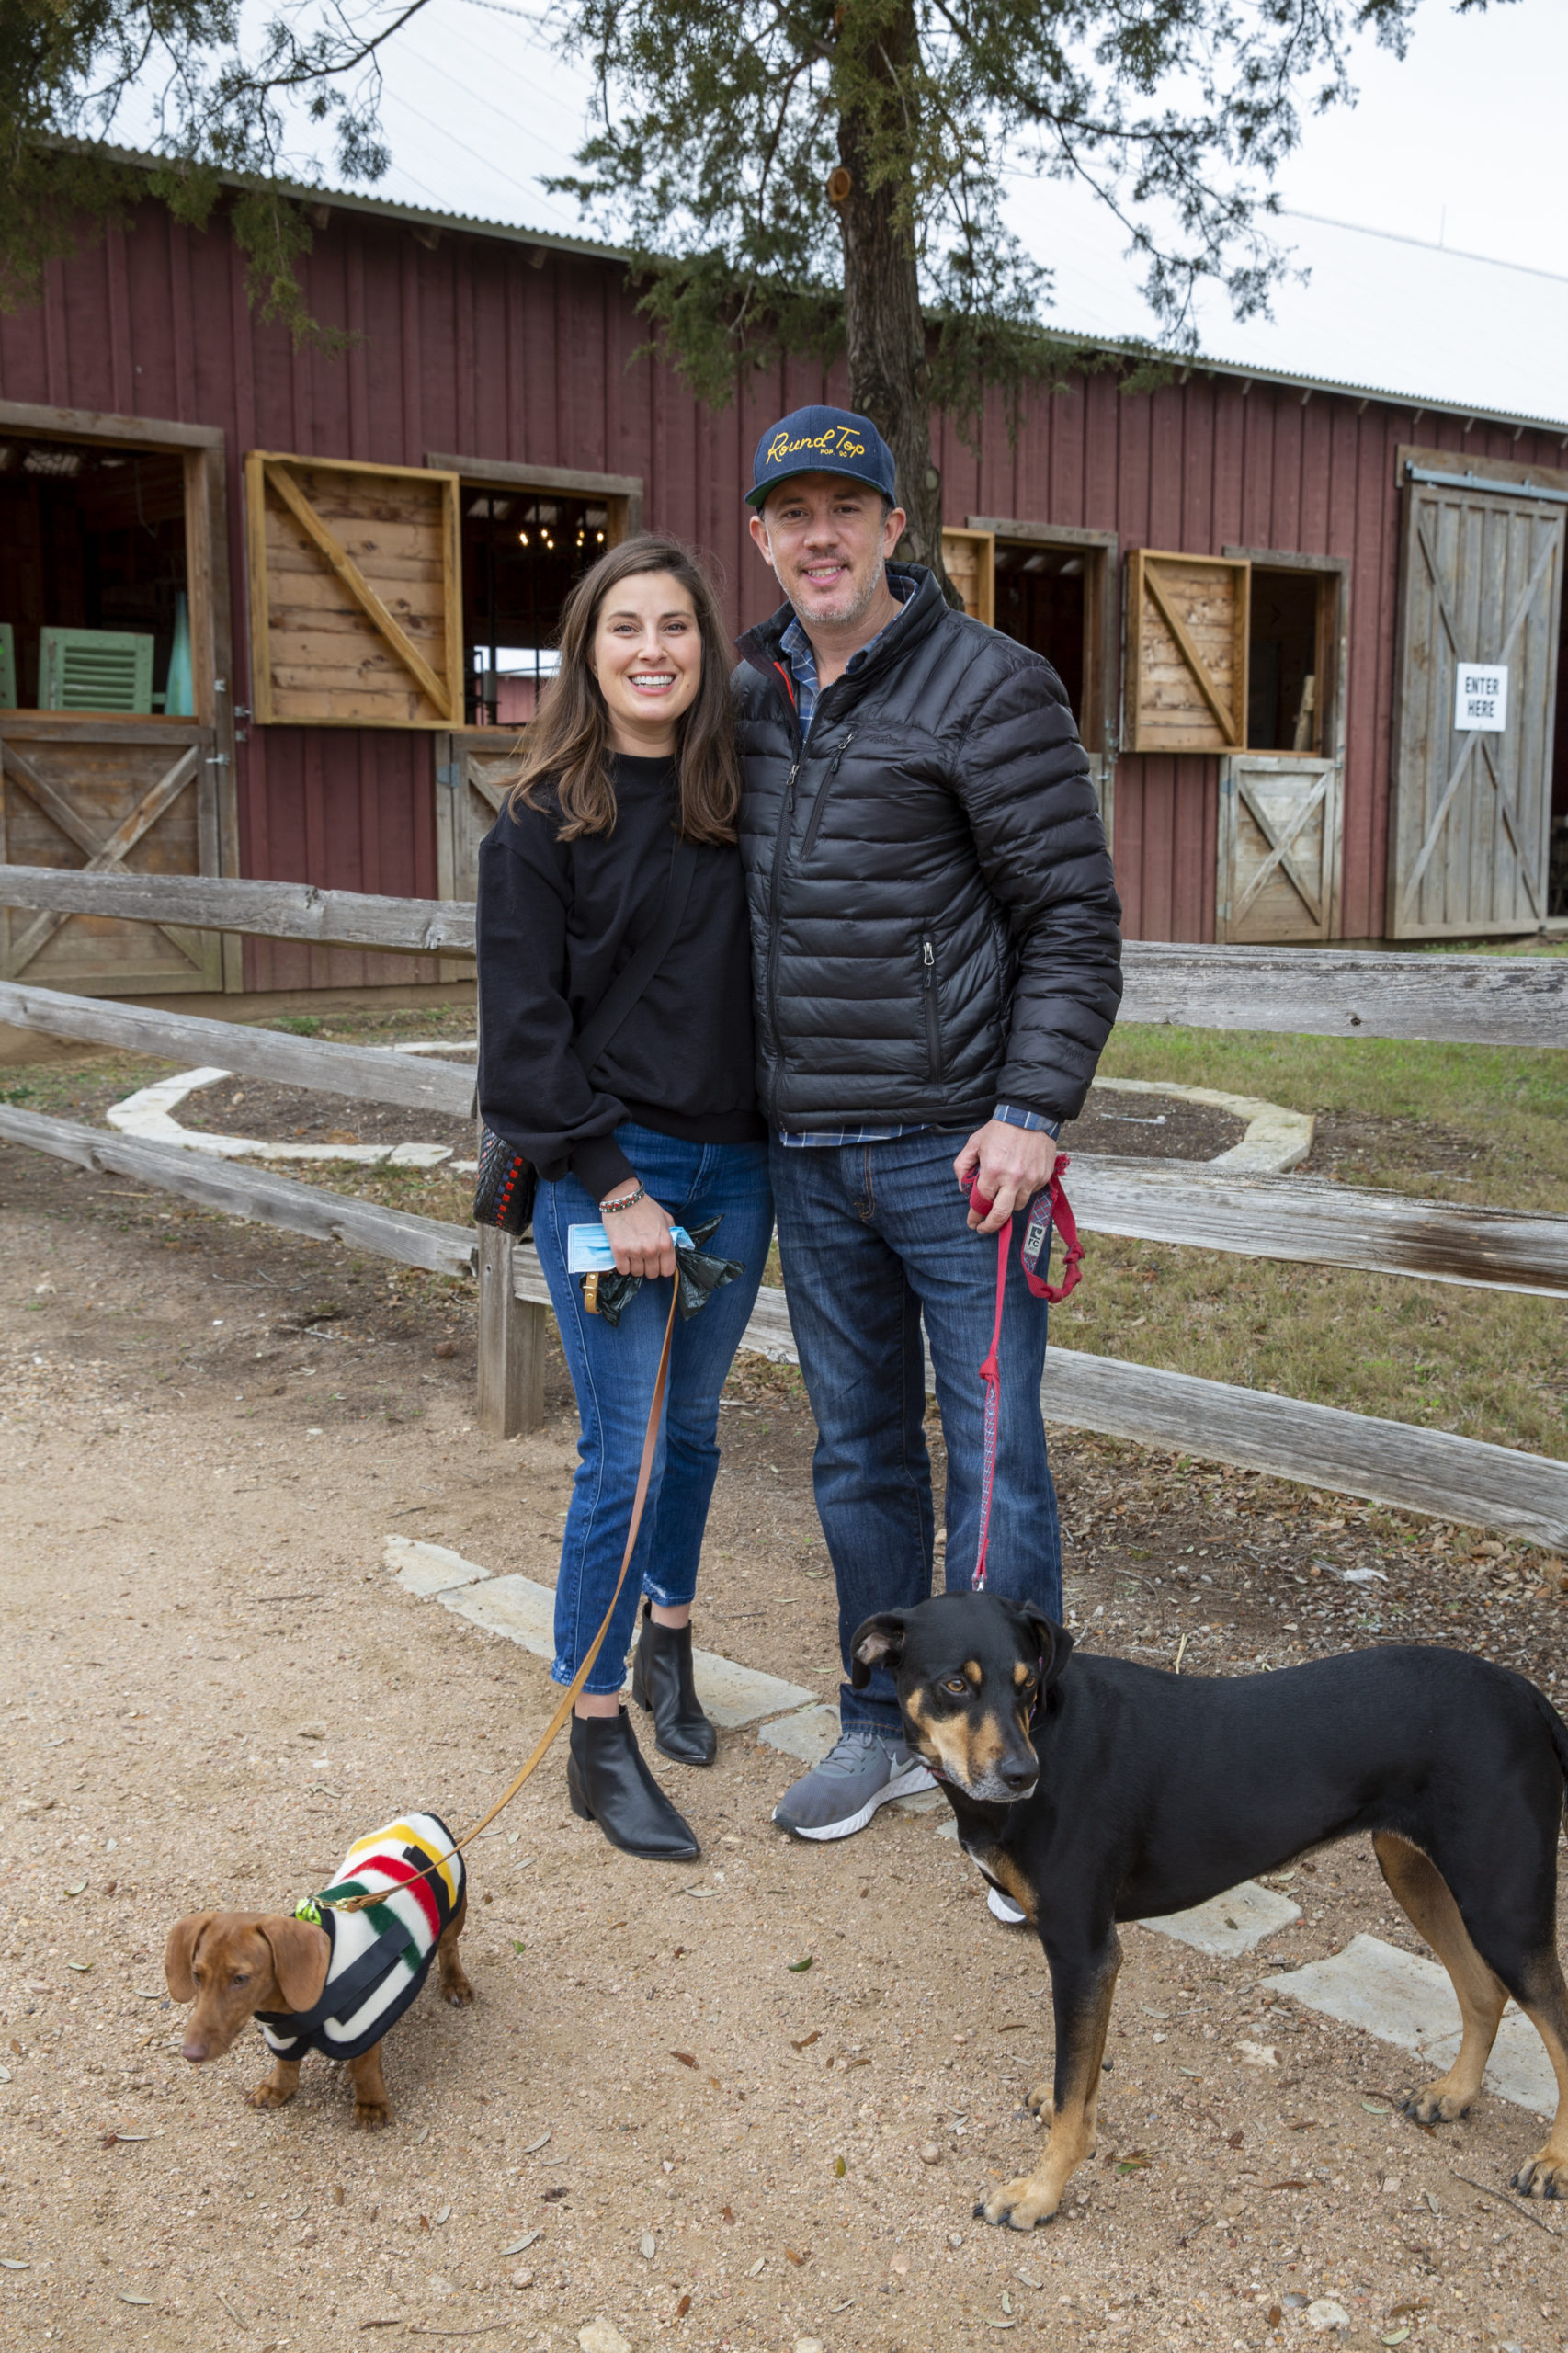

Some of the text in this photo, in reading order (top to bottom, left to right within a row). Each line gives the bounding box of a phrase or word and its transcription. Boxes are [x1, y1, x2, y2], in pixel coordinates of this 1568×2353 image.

[766, 426, 865, 465] Round Top
[820, 448, 835, 456] POP.
[1465, 676, 1499, 695] ENTER
[1468, 699, 1495, 717] HERE
